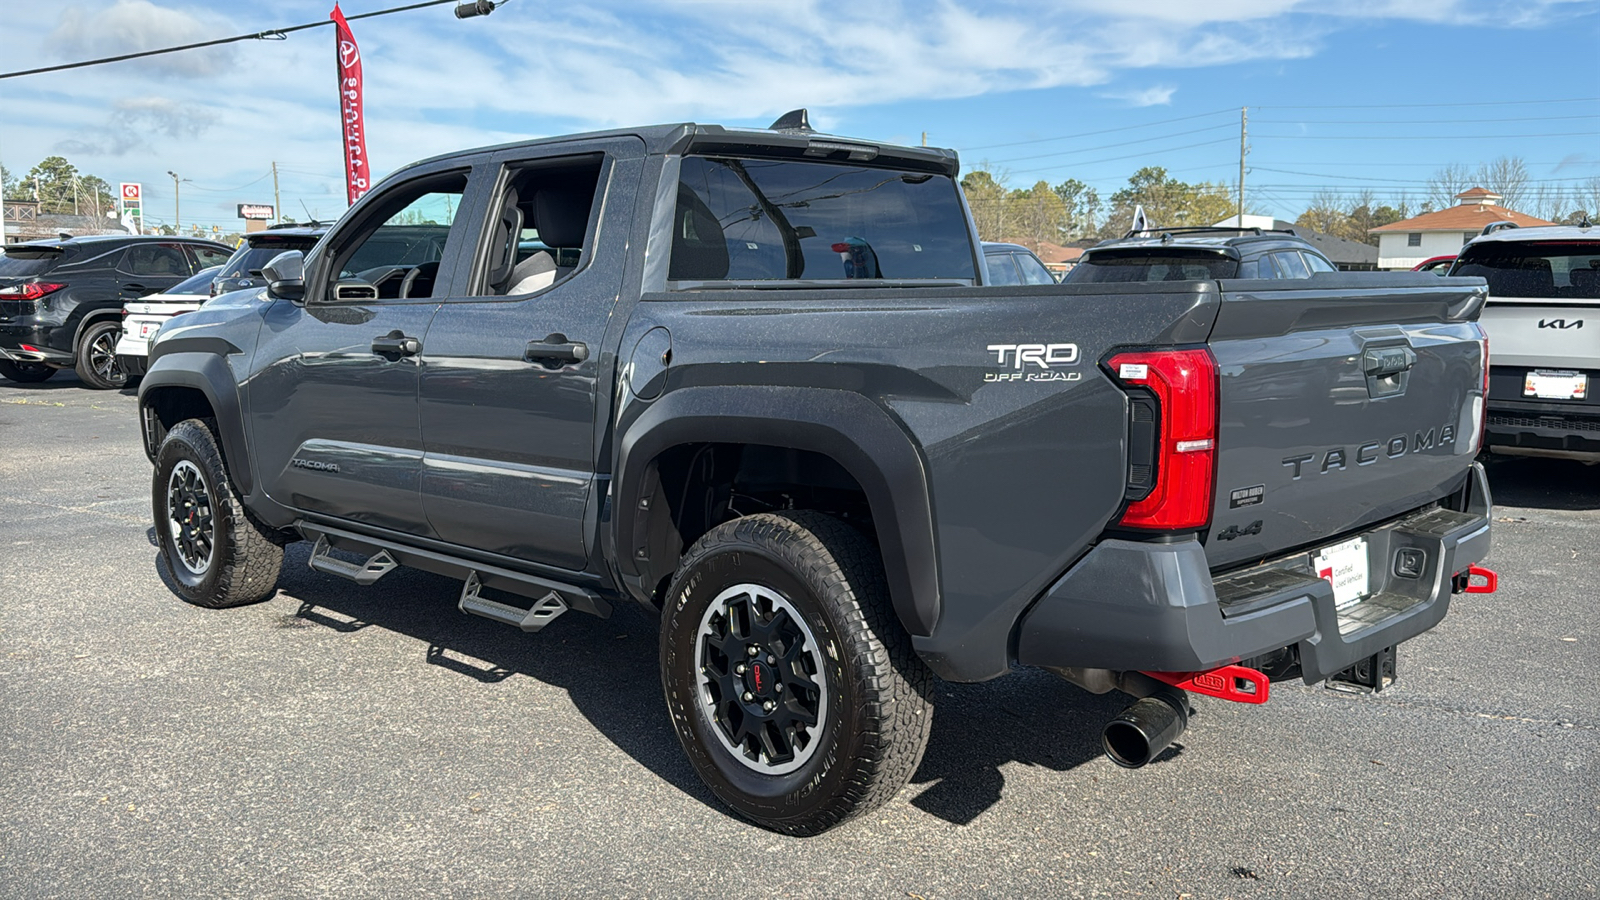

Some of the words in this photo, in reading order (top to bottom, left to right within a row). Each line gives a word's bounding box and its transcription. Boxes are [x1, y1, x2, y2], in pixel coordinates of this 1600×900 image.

[1538, 318, 1583, 329] KIA
[986, 343, 1081, 371] TRD
[983, 372, 1023, 382] OFF
[1025, 372, 1082, 382] ROAD
[1282, 423, 1457, 481] TACOMA
[292, 458, 339, 473] TACOMA
[1335, 563, 1354, 577] Certified
[1197, 673, 1223, 689] ARB
